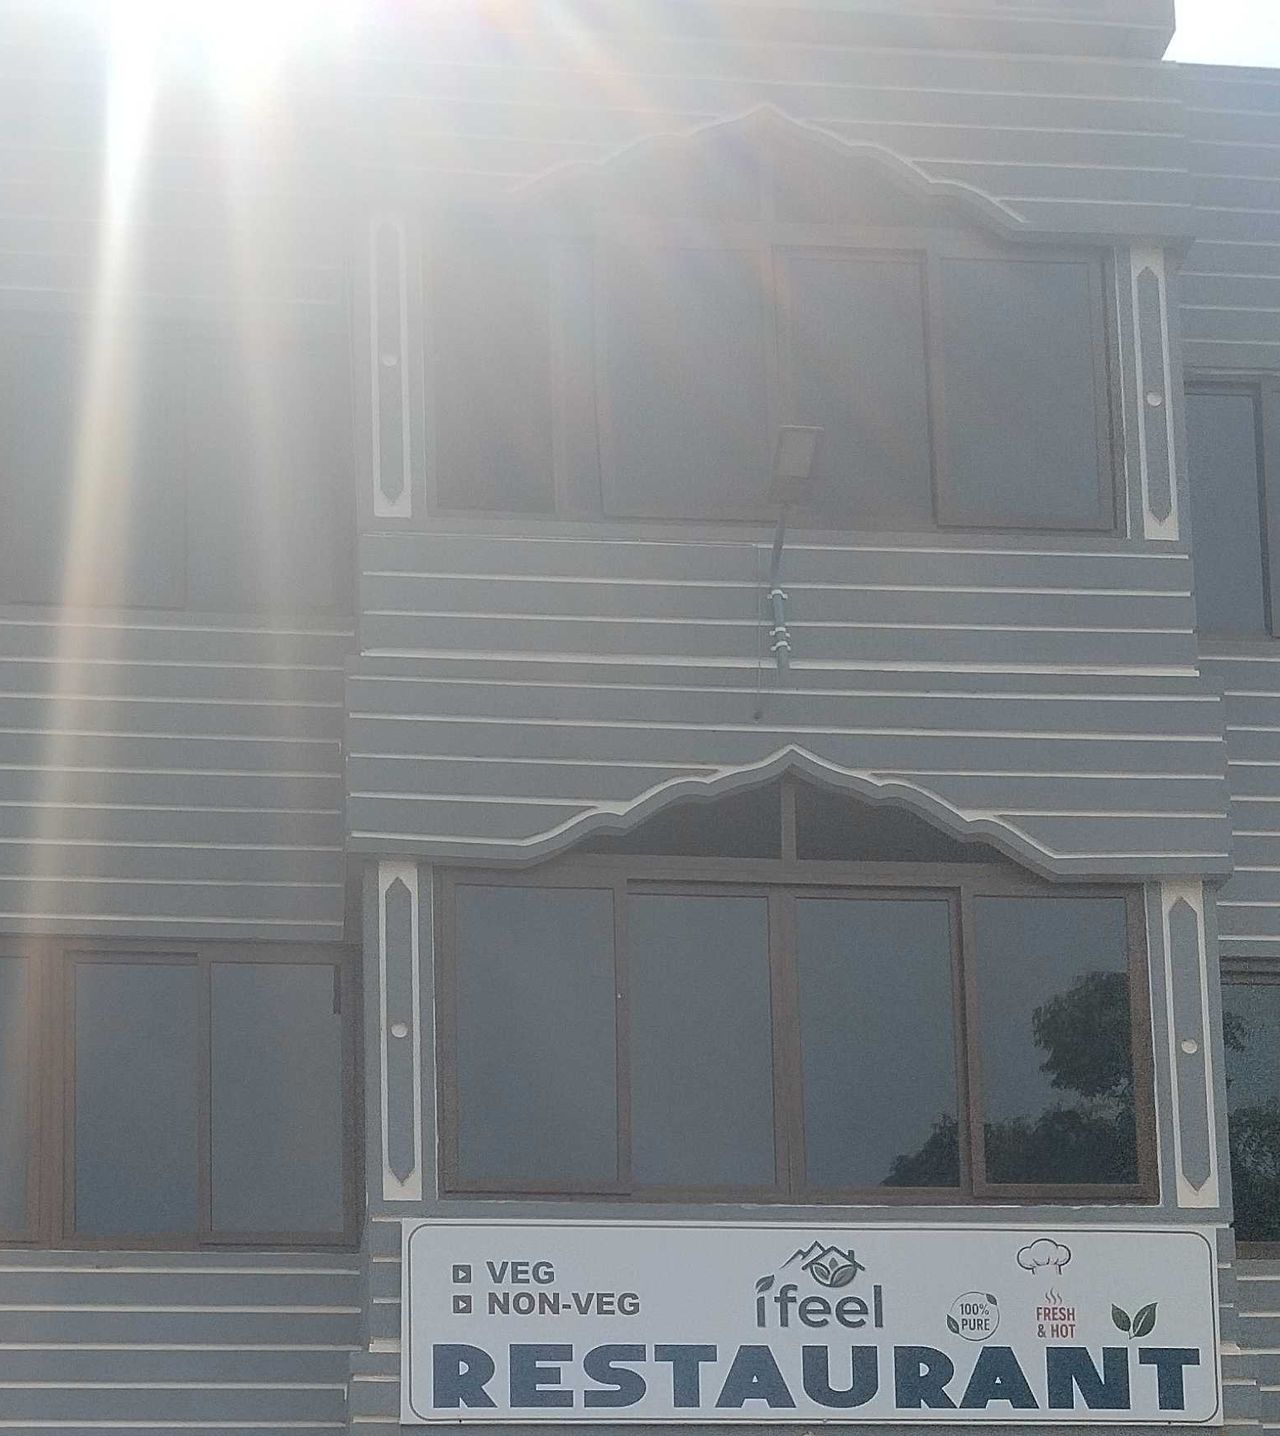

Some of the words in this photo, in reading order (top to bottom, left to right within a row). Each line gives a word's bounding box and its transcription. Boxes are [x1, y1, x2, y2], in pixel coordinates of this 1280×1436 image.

[486, 1261, 555, 1284] VEG
[488, 1292, 640, 1315] NON-VEG
[755, 1275, 883, 1328] ifeel
[959, 1303, 990, 1316] 100%
[1036, 1307, 1075, 1322] FRESH
[961, 1318, 990, 1331] PURE
[1037, 1324, 1046, 1338] &
[1051, 1325, 1076, 1338] HOT
[431, 1343, 1201, 1410] RESTAURANT
